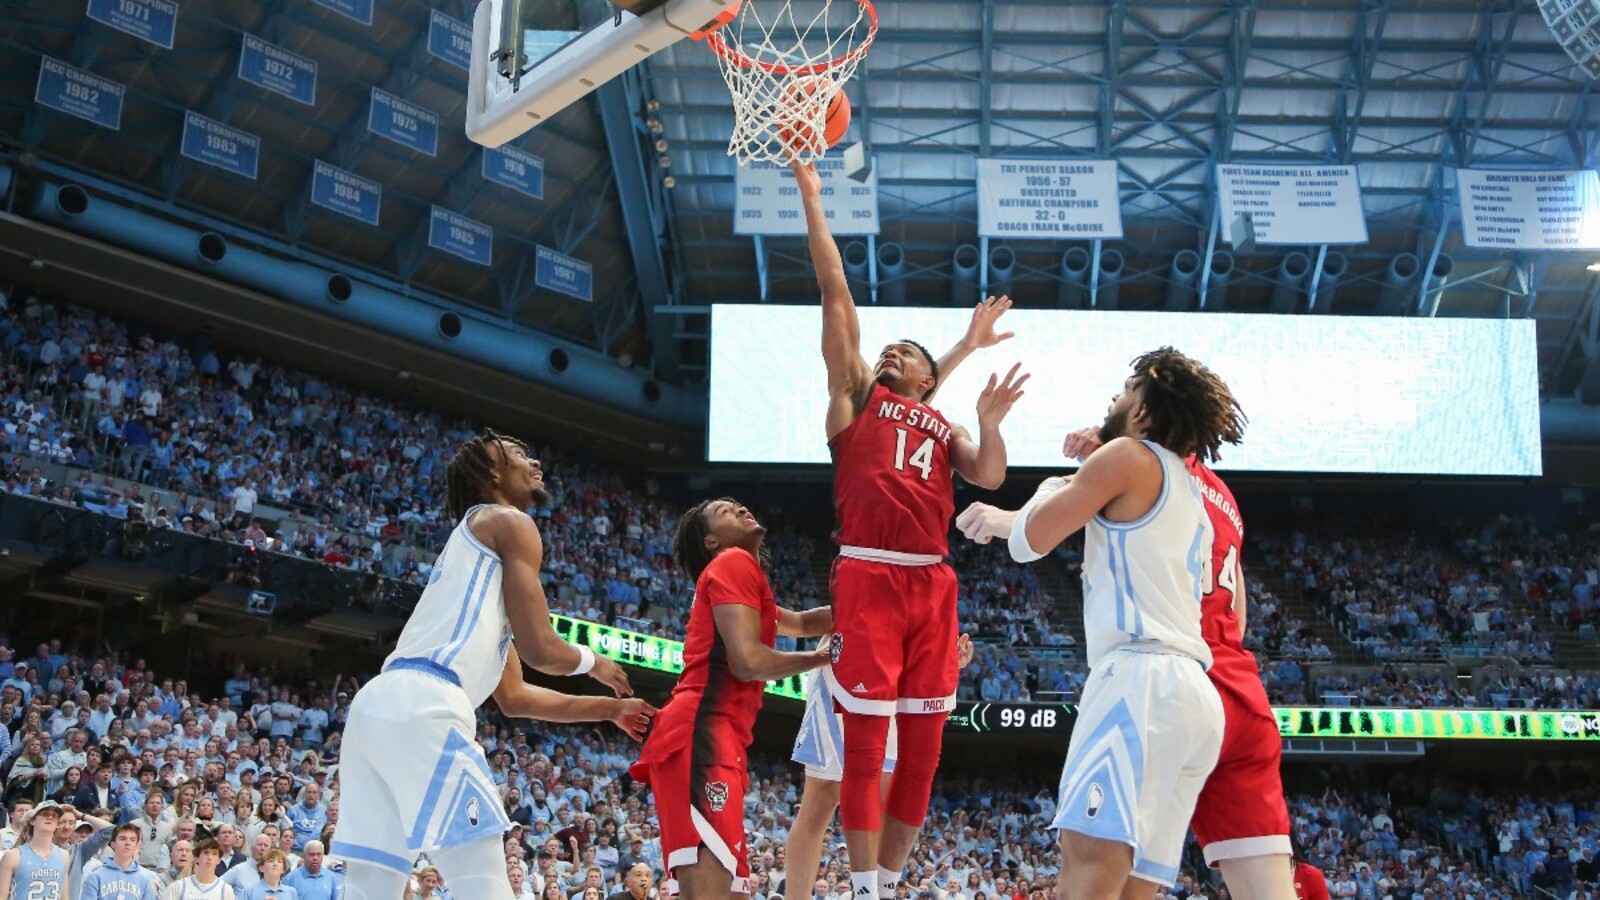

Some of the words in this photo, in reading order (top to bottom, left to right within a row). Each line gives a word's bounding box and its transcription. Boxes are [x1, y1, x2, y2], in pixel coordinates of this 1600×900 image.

[120, 0, 150, 20] 1971
[451, 36, 472, 54] 198
[264, 46, 314, 73] CHAMPIONS
[44, 60, 64, 76] ACC
[66, 68, 121, 96] CHAMPIONS
[265, 60, 294, 80] 1972
[64, 81, 99, 104] 1982
[392, 112, 417, 132] 1975
[207, 134, 236, 154] 1983
[1000, 165, 1017, 174] THE
[1020, 165, 1056, 174] PERFECT
[1060, 166, 1094, 174] SEASON
[1262, 168, 1298, 177] ACADEMIC
[1316, 169, 1349, 177] AMERICA
[1025, 176, 1051, 186] 1956
[1060, 177, 1072, 186] 57
[334, 182, 360, 202] 1984
[742, 187, 762, 196] 1922
[778, 187, 798, 196] 1924
[1021, 188, 1077, 198] UNDEFEATED
[998, 200, 1041, 208] NATIONAL
[1044, 200, 1098, 208] CHAMPIONS
[778, 210, 798, 218] 1936
[1035, 210, 1050, 220] 32
[998, 222, 1029, 231] COACH
[1031, 223, 1060, 232] FRANK
[1062, 223, 1104, 232] McGUIRE
[554, 265, 576, 282] 1987
[878, 400, 906, 420] NC
[894, 427, 933, 481] 14
[594, 632, 660, 661] POWERING
[662, 647, 670, 662] A
[1000, 708, 1025, 728] 99
[1030, 709, 1056, 728] dB
[32, 868, 60, 880] NORTH
[28, 880, 60, 900] 23
[101, 880, 141, 898] CAROLINA
